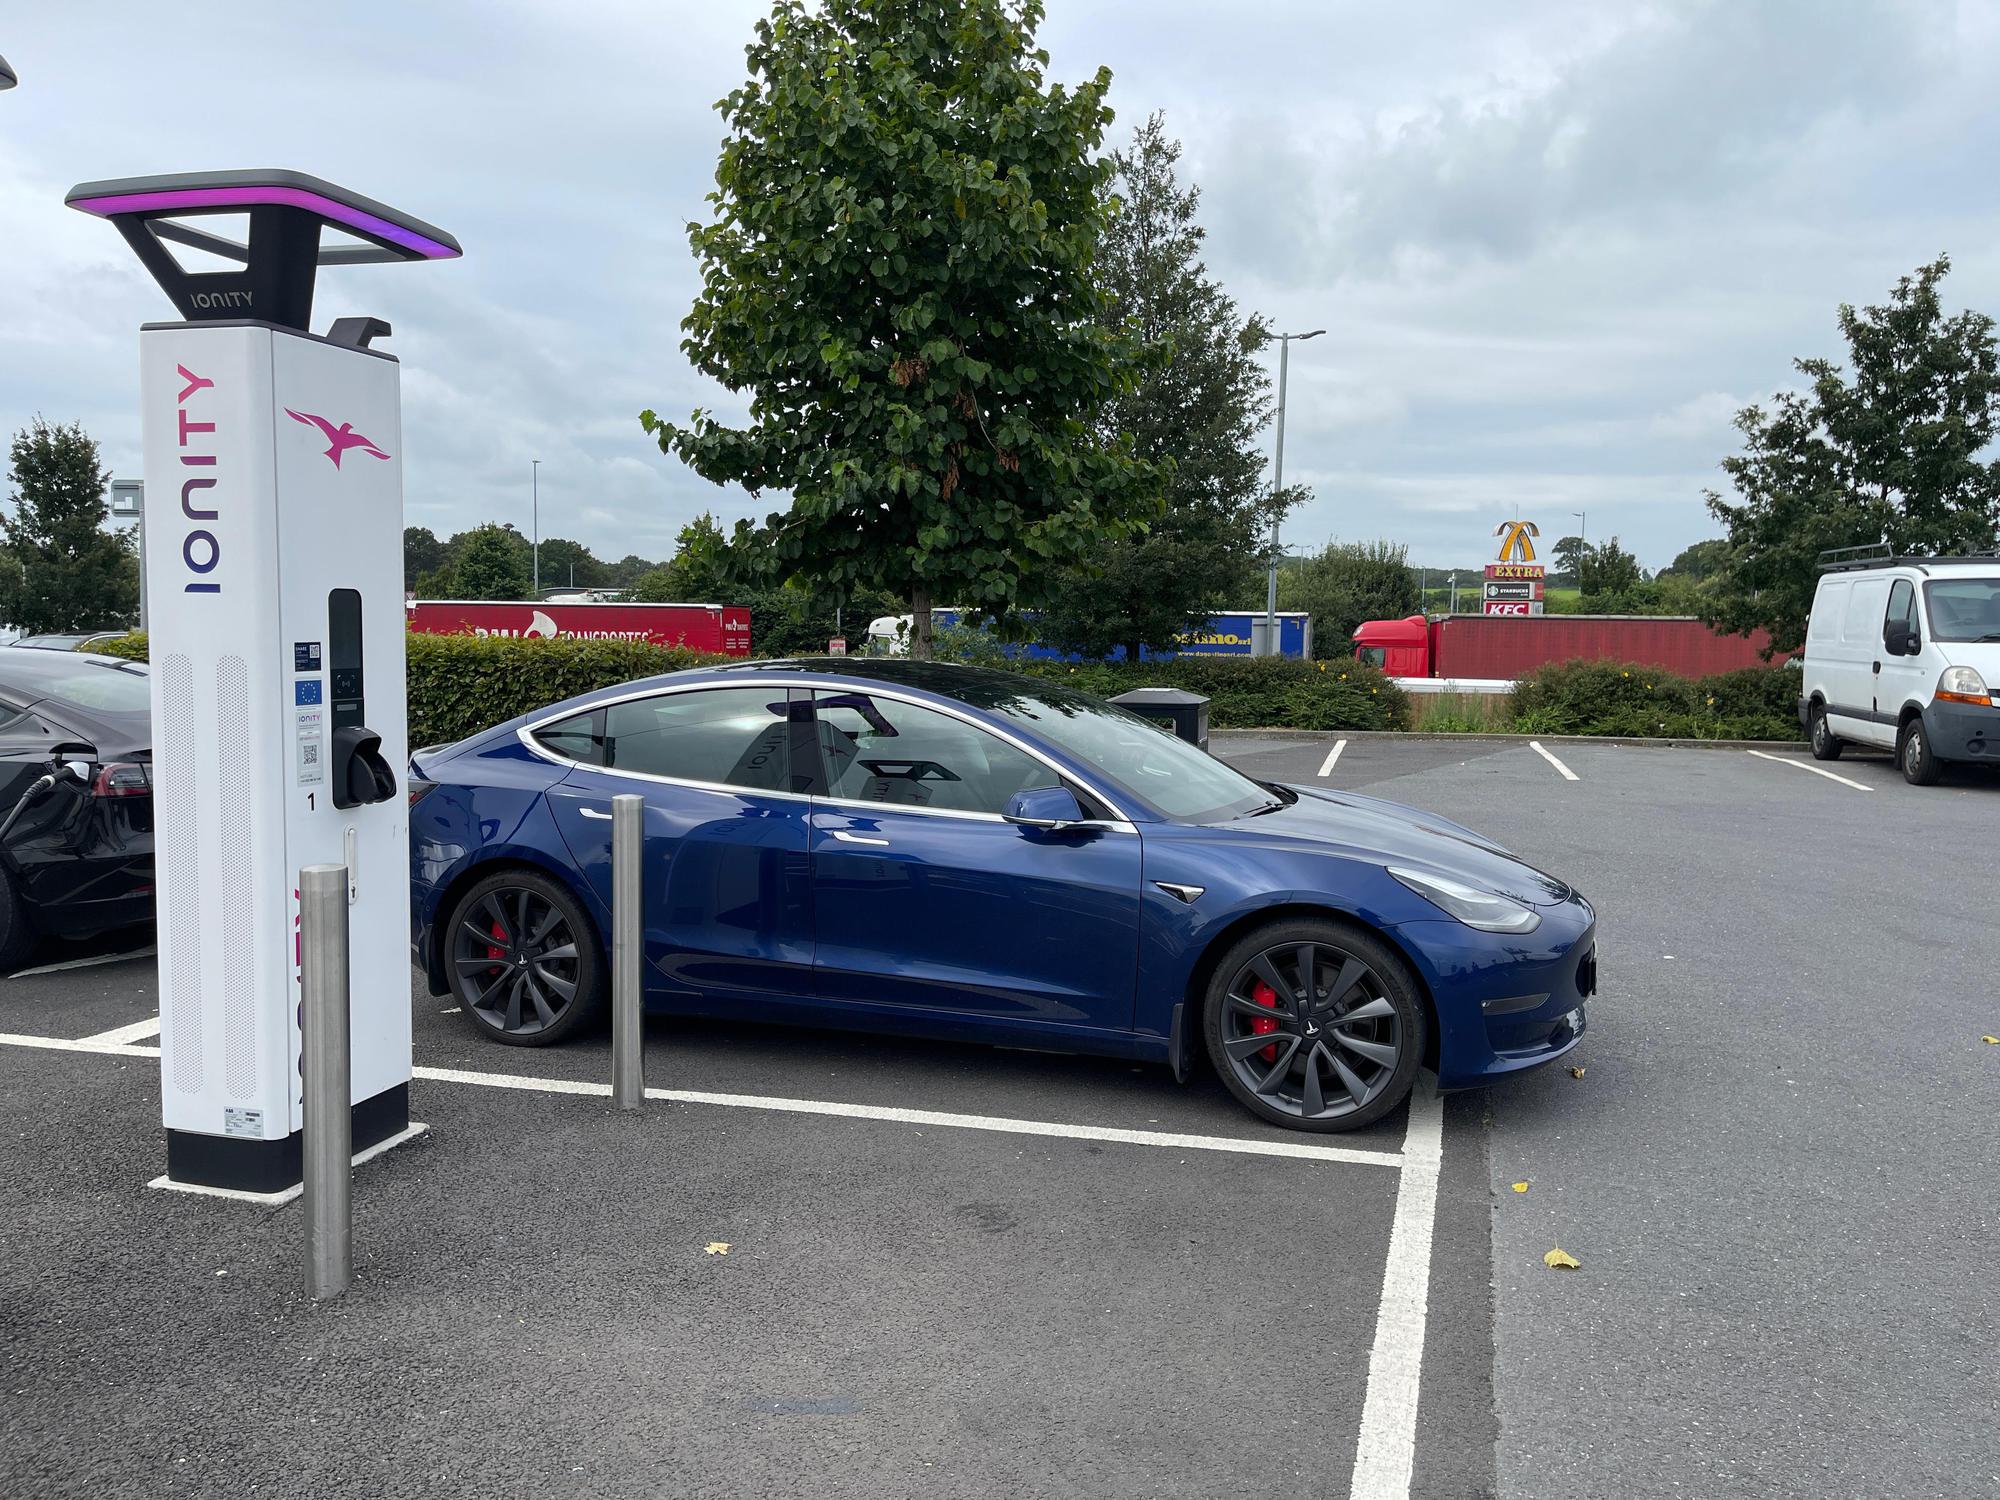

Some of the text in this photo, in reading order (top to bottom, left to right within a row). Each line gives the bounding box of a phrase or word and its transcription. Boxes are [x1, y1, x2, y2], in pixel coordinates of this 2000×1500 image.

[190, 291, 252, 308] IONITY
[177, 363, 221, 593] IONITY
[1495, 567, 1542, 577] EXTRA
[1490, 604, 1525, 616] KFC
[298, 714, 321, 723] IONITY
[307, 792, 315, 811] 1
